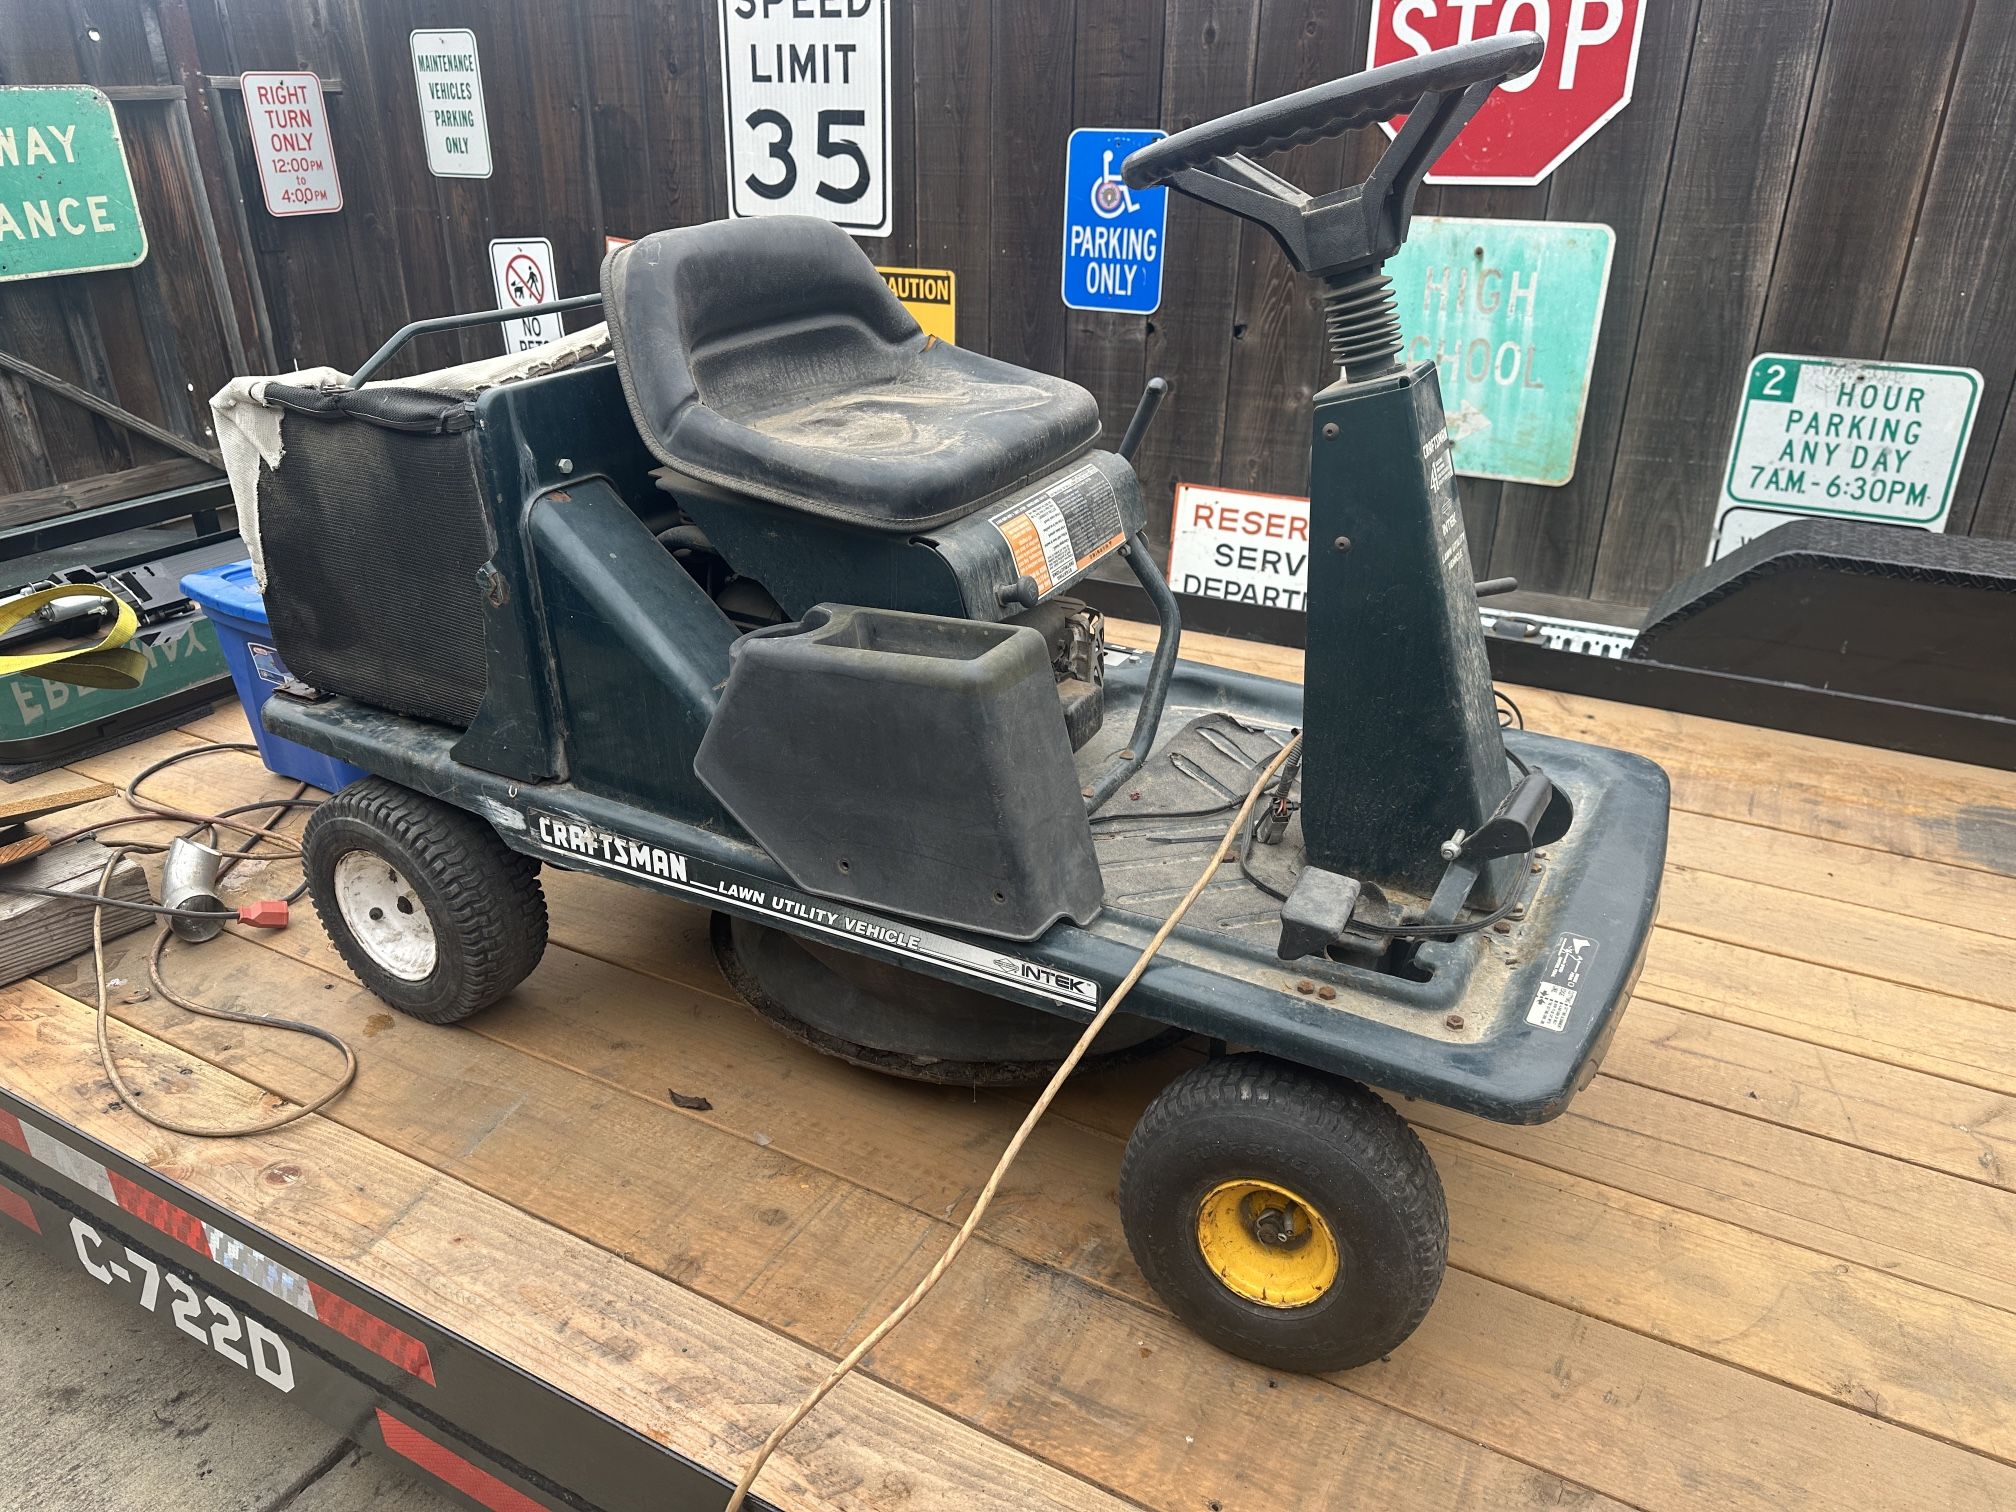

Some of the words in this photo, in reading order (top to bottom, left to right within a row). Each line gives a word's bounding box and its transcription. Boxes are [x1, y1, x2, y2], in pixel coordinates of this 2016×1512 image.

[418, 54, 474, 72] MAINTENANCE
[750, 43, 856, 84] LIMIT
[1392, 0, 1623, 93] STOP
[257, 85, 307, 105] RIGHT
[429, 82, 472, 100] VEHICLES
[264, 109, 313, 129] TURN
[434, 110, 474, 127] PARKING
[271, 132, 313, 152] ONLY
[445, 137, 468, 154] ONLY
[745, 108, 871, 204] 35
[296, 175, 306, 186] to
[0, 195, 116, 242] ANCE
[1071, 225, 1157, 262] PARKING
[886, 276, 949, 300] AUTION
[1086, 261, 1137, 296] ONLY
[1424, 265, 1538, 319] HIGH
[522, 316, 541, 337] NO
[1763, 364, 1786, 396] 2
[1836, 382, 1926, 413] HOUR
[1785, 409, 1922, 445] PARKING
[1778, 439, 1841, 467] ANY
[1850, 445, 1911, 474] DAY
[1183, 573, 1306, 611] DEPART
[539, 816, 687, 882] CRAFTSMAN
[718, 881, 765, 905] LAWN
[772, 896, 839, 925] UTILITY
[844, 917, 920, 950] VEHICLE
[1021, 963, 1084, 994] INTEK
[69, 1217, 295, 1393] C-722D
